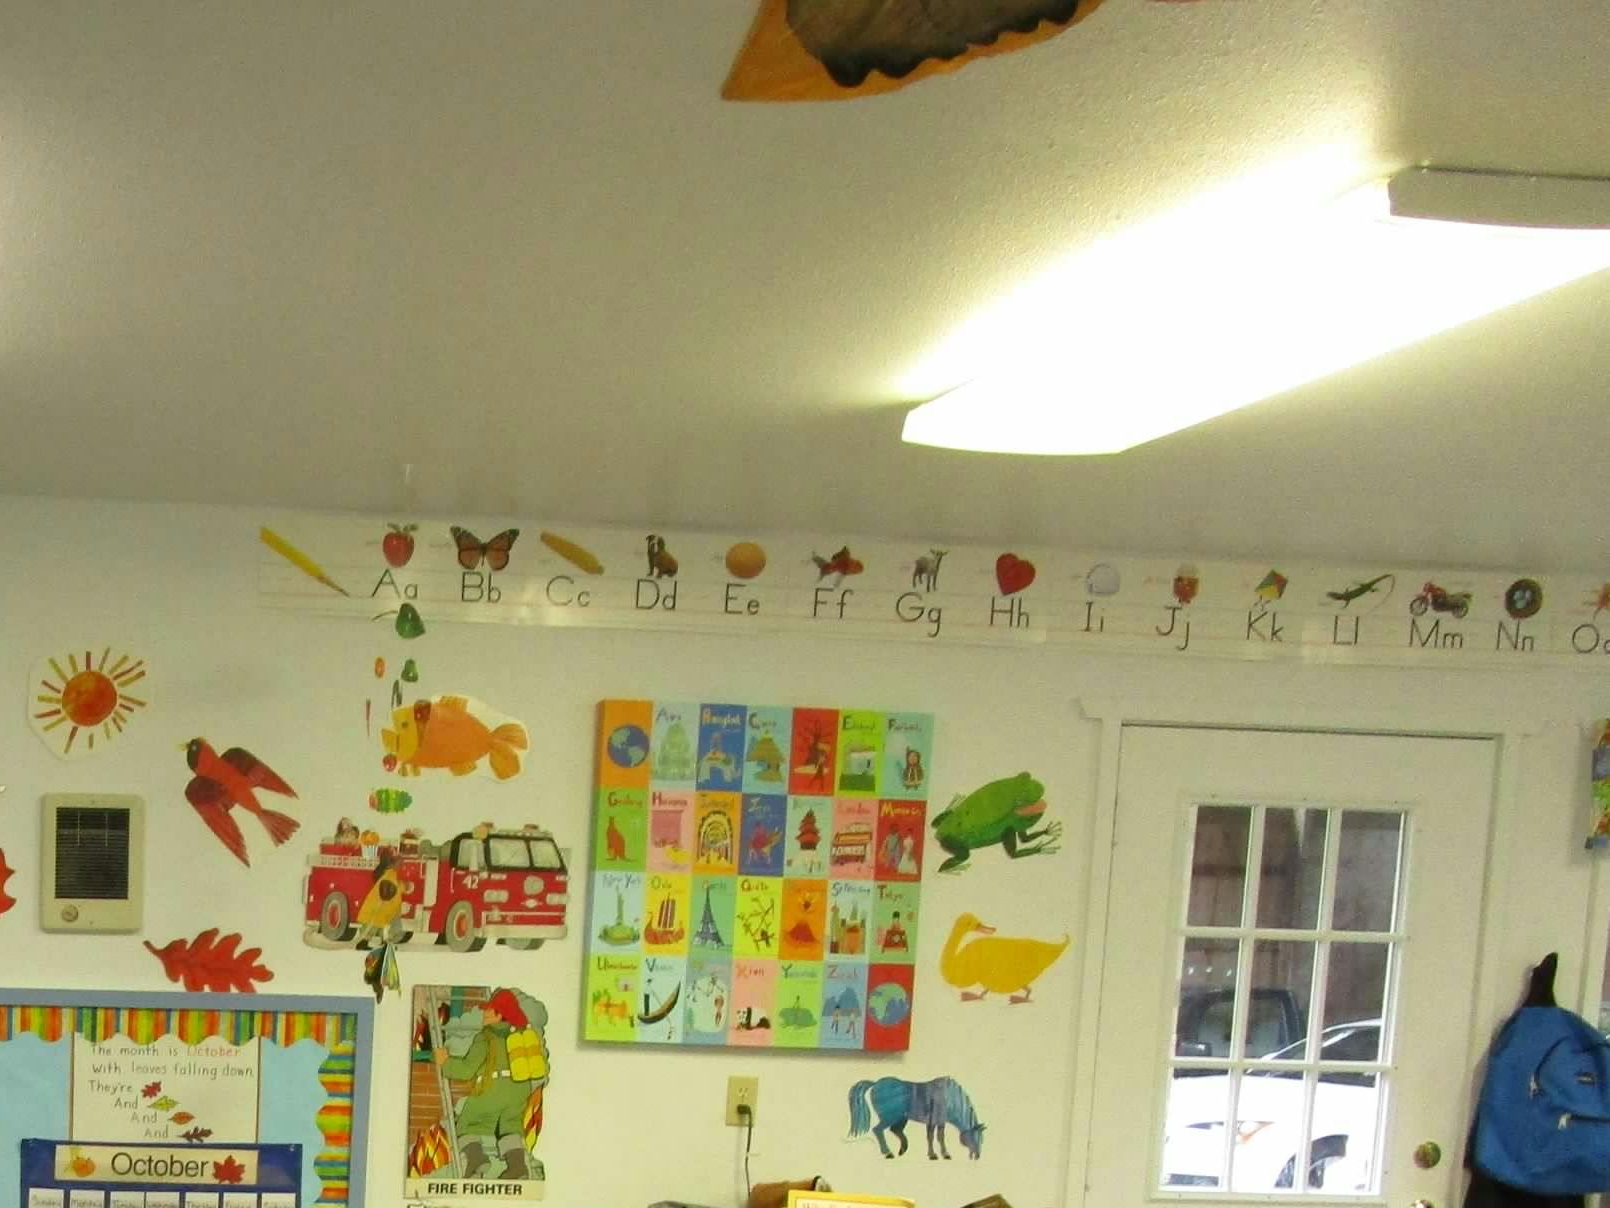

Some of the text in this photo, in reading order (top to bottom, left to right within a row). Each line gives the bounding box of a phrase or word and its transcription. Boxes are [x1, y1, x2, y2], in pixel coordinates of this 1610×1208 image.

[371, 569, 418, 599] Aa
[461, 571, 502, 603] Bb
[546, 575, 590, 607] Cc
[636, 578, 677, 610] Dd
[725, 583, 760, 615] Ee
[814, 588, 854, 619] Ff
[896, 592, 942, 638] Gg
[990, 596, 1030, 628] Hh
[1080, 602, 1104, 632] Ii
[1156, 606, 1190, 651] Jj
[1246, 611, 1284, 642] Kk
[1333, 616, 1359, 645] Ll
[1409, 618, 1463, 649] Mm
[1497, 620, 1534, 651] Nn
[462, 875, 479, 889] 42
[120, 1045, 159, 1056] month
[169, 1045, 178, 1056] is
[132, 1061, 167, 1074] leaves
[174, 1062, 218, 1080] falling
[114, 1097, 139, 1109] And
[130, 1112, 157, 1123] And
[144, 1126, 169, 1138] And
[111, 1152, 209, 1177] October
[428, 1182, 522, 1196] FIRE FIGHTER
